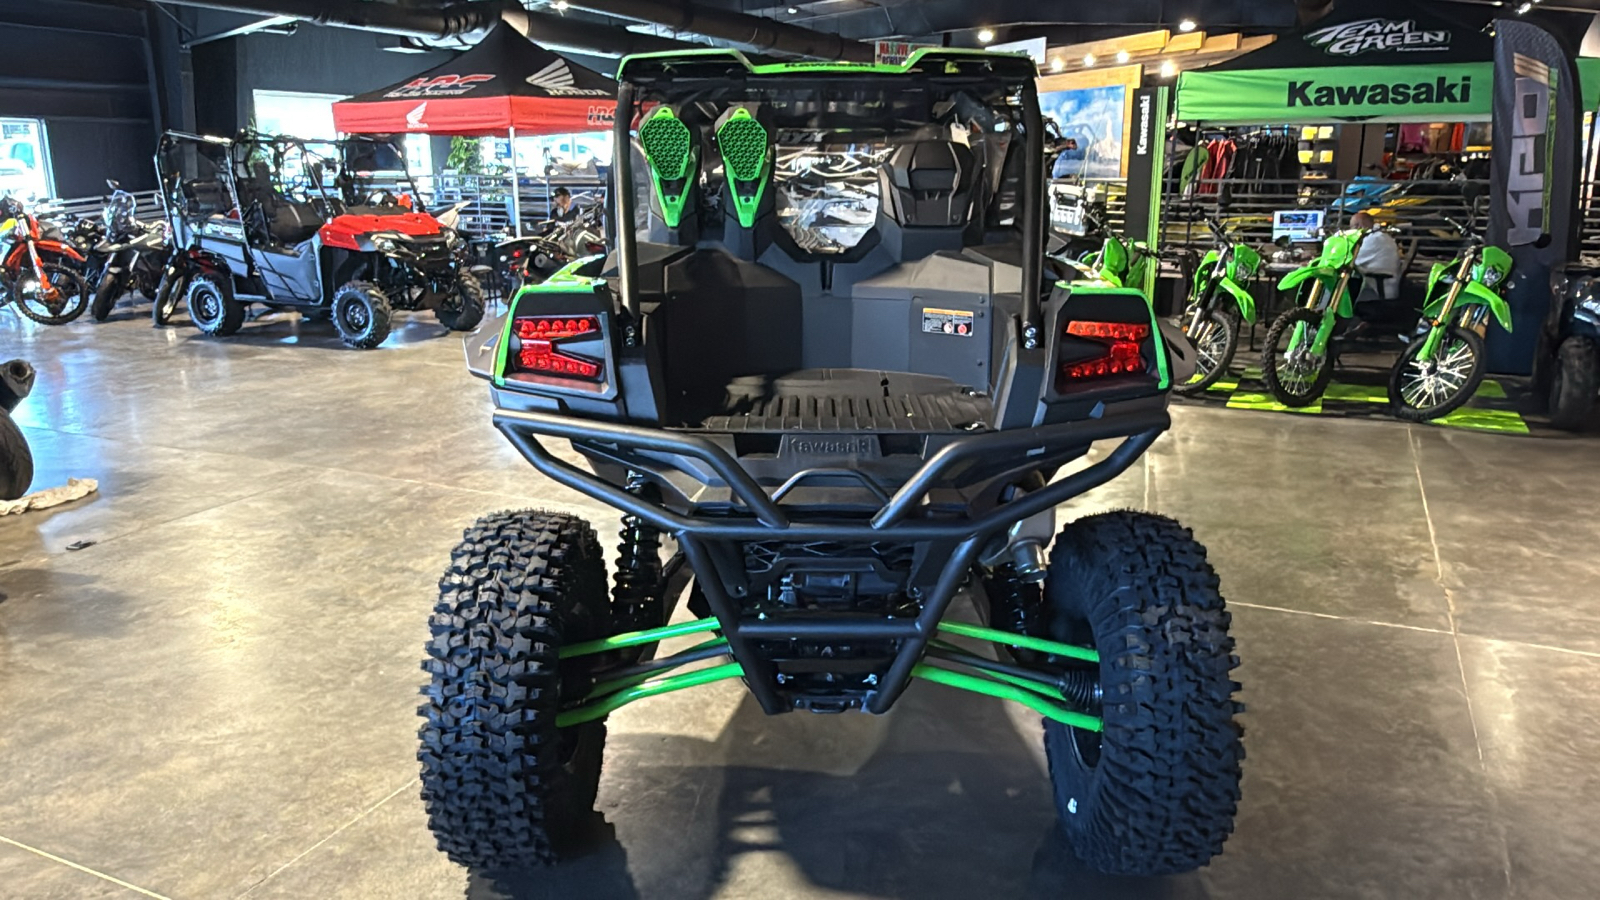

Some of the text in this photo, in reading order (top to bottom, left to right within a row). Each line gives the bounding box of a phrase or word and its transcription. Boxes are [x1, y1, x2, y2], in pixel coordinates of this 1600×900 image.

[1305, 18, 1411, 44] TEAM
[1328, 31, 1447, 54] GREEN
[545, 87, 612, 96] HONDA
[1287, 76, 1472, 108] Kawasaki
[1136, 94, 1151, 155] Kawasaki
[787, 437, 872, 454] Kawasaki
